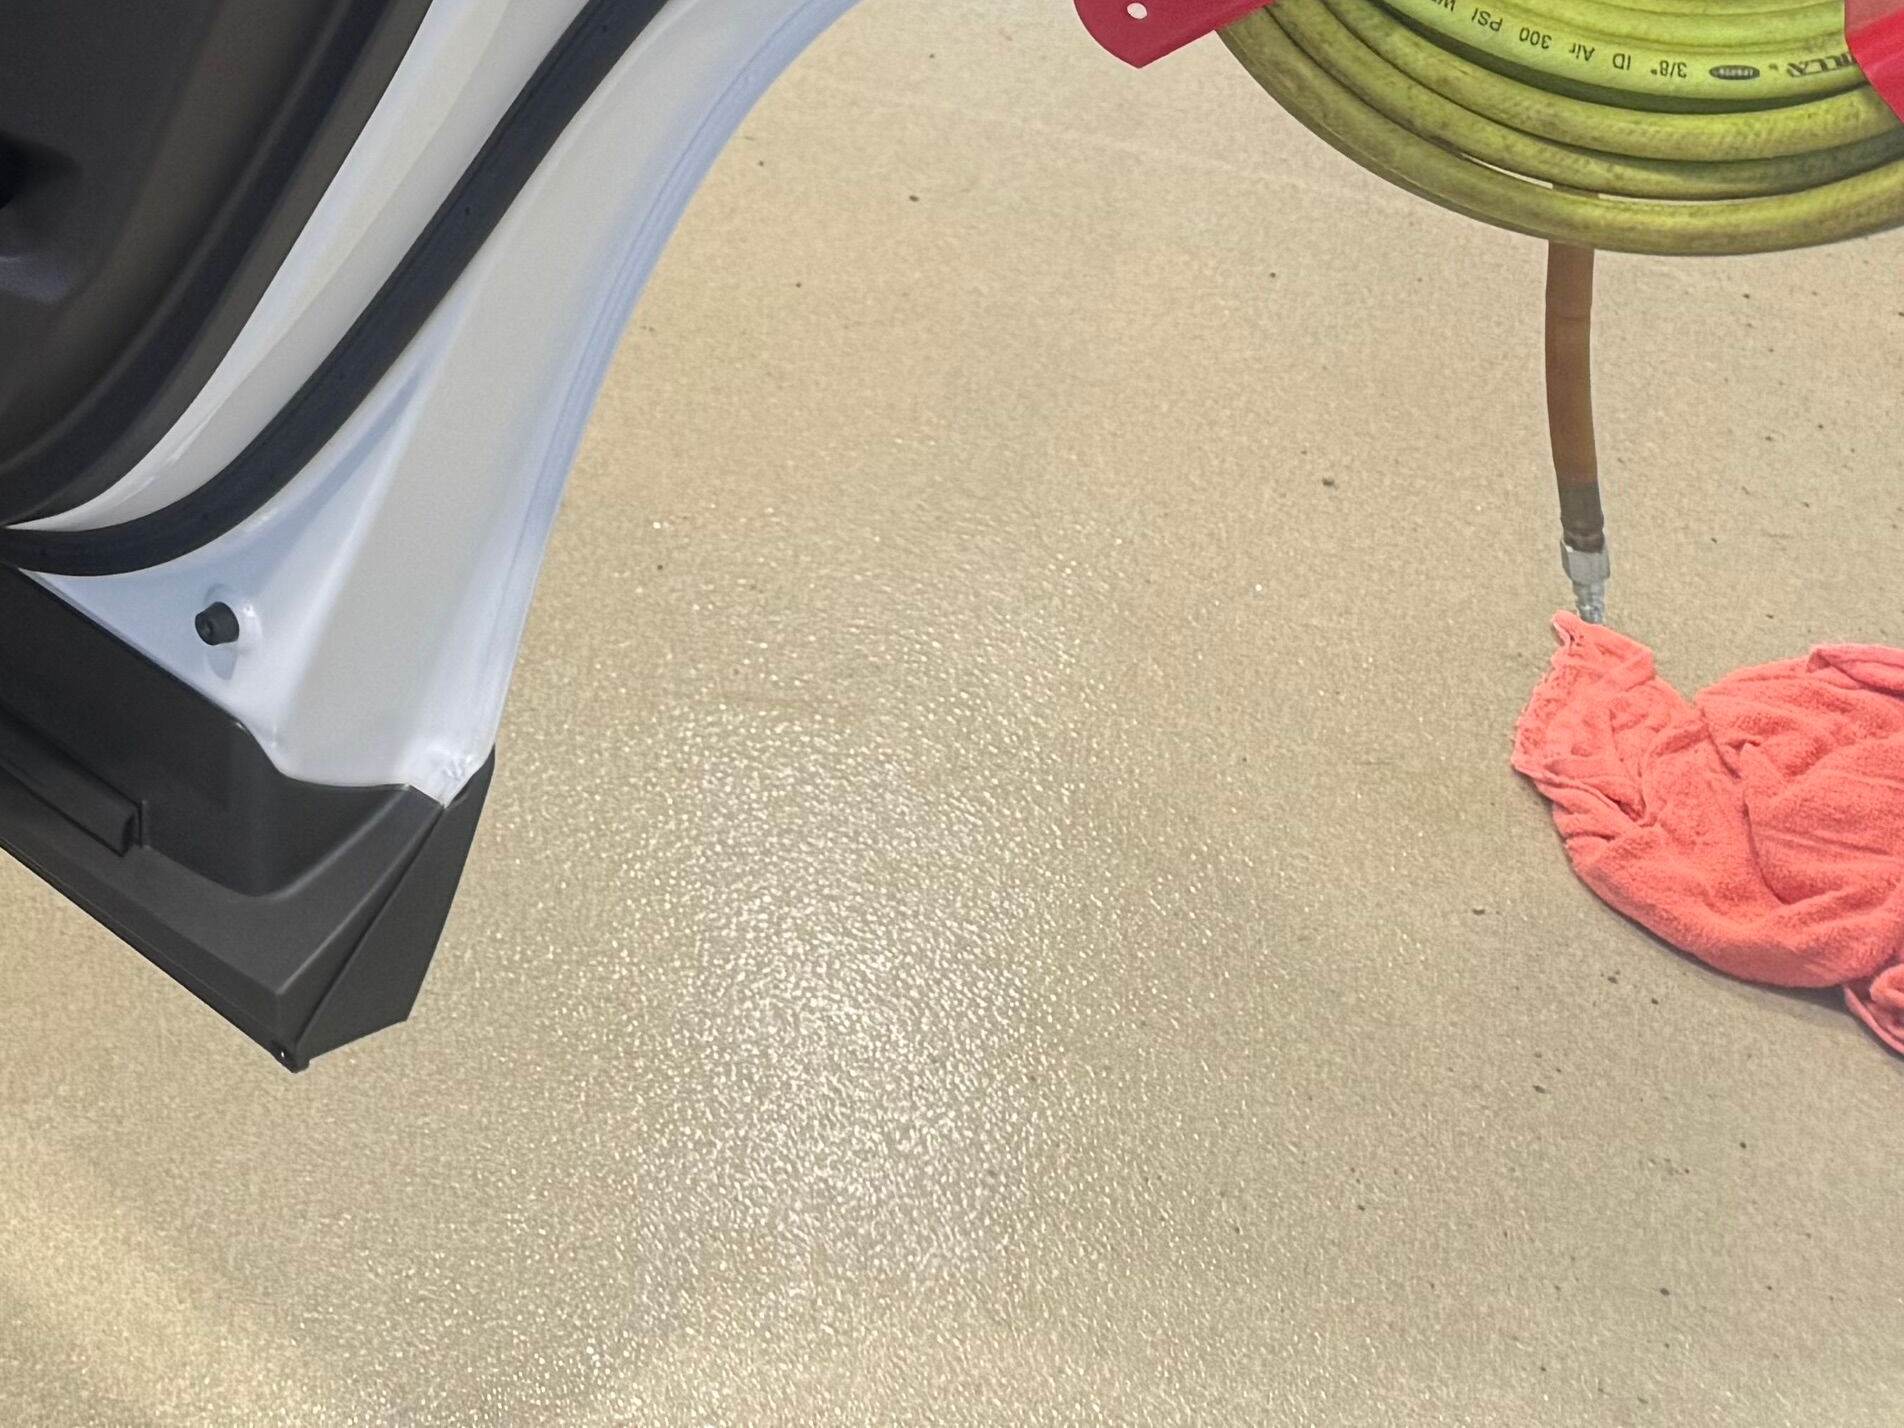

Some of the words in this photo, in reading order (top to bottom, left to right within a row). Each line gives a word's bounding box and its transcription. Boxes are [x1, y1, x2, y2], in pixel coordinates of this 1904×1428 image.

[1471, 7, 1504, 33] PSI
[1519, 26, 1553, 50] 300
[1568, 42, 1597, 62] Air
[1612, 52, 1632, 71] ID
